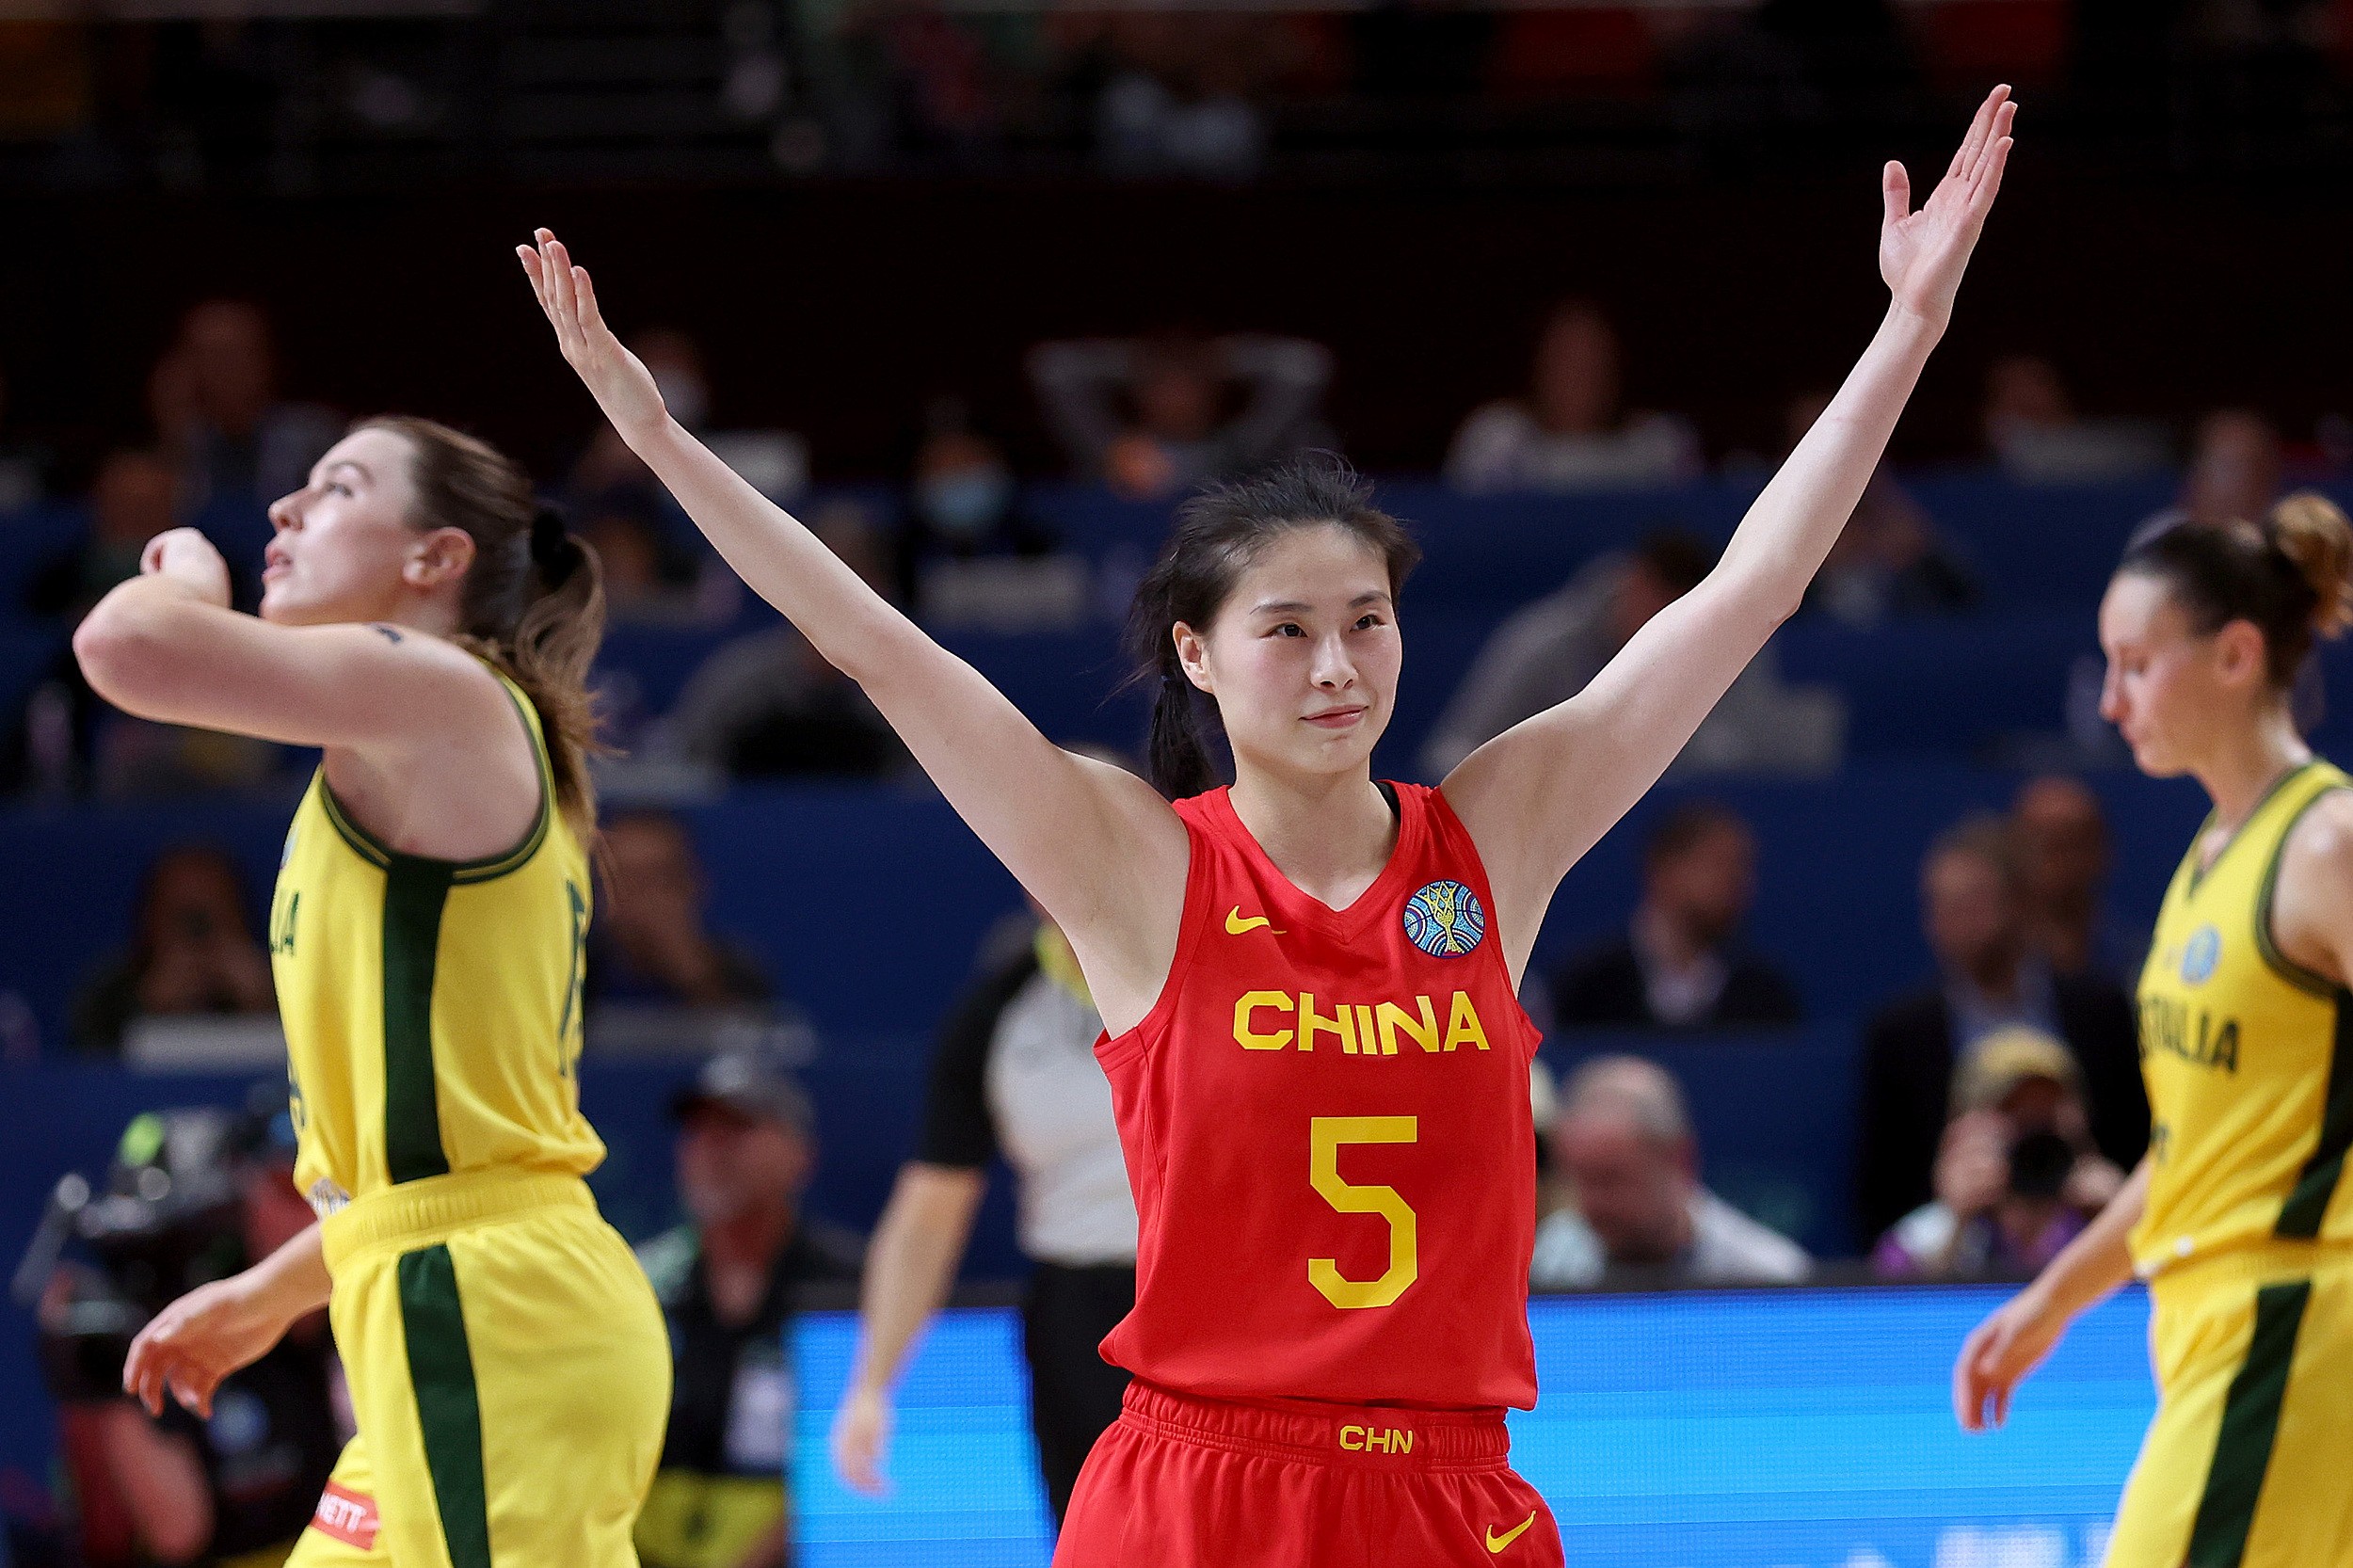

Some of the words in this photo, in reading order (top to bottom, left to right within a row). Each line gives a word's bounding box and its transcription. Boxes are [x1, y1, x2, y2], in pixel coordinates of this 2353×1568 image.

[1233, 990, 1491, 1056] CHINA
[1308, 1115, 1418, 1309] 5
[1339, 1425, 1414, 1454] CHN
